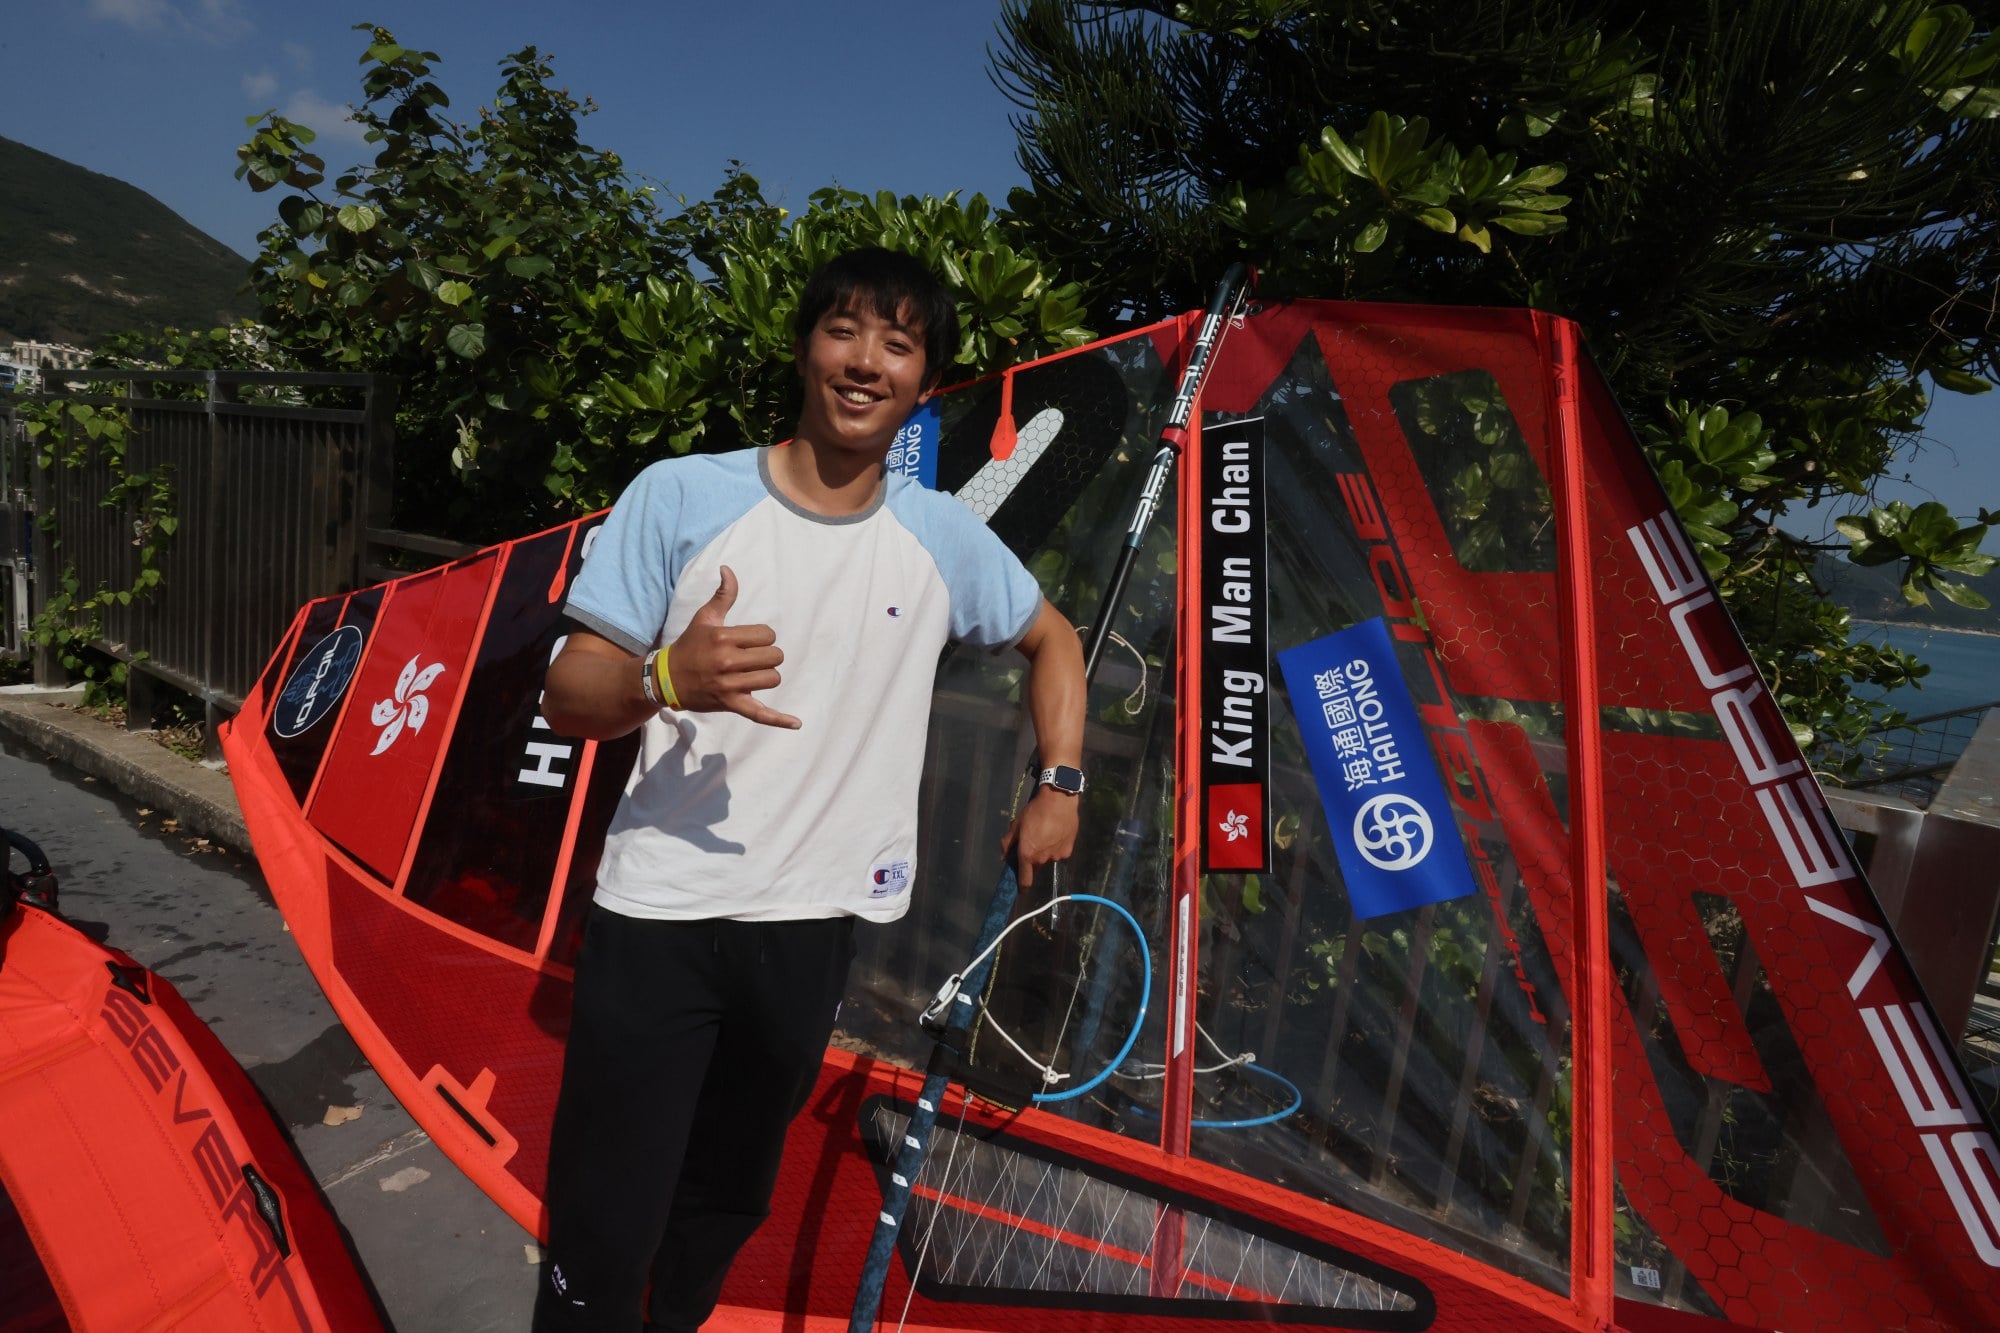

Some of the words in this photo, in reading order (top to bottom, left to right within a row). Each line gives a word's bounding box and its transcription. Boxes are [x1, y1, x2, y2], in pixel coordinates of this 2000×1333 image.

[1211, 441, 1251, 534] Chan
[1211, 556, 1252, 644] Man
[1211, 669, 1264, 768] King
[1313, 666, 1379, 793] 海通國際
[1345, 658, 1406, 783] HAITONG
[892, 870, 905, 880] XXL
[1627, 509, 2000, 1268] SEVERNE
